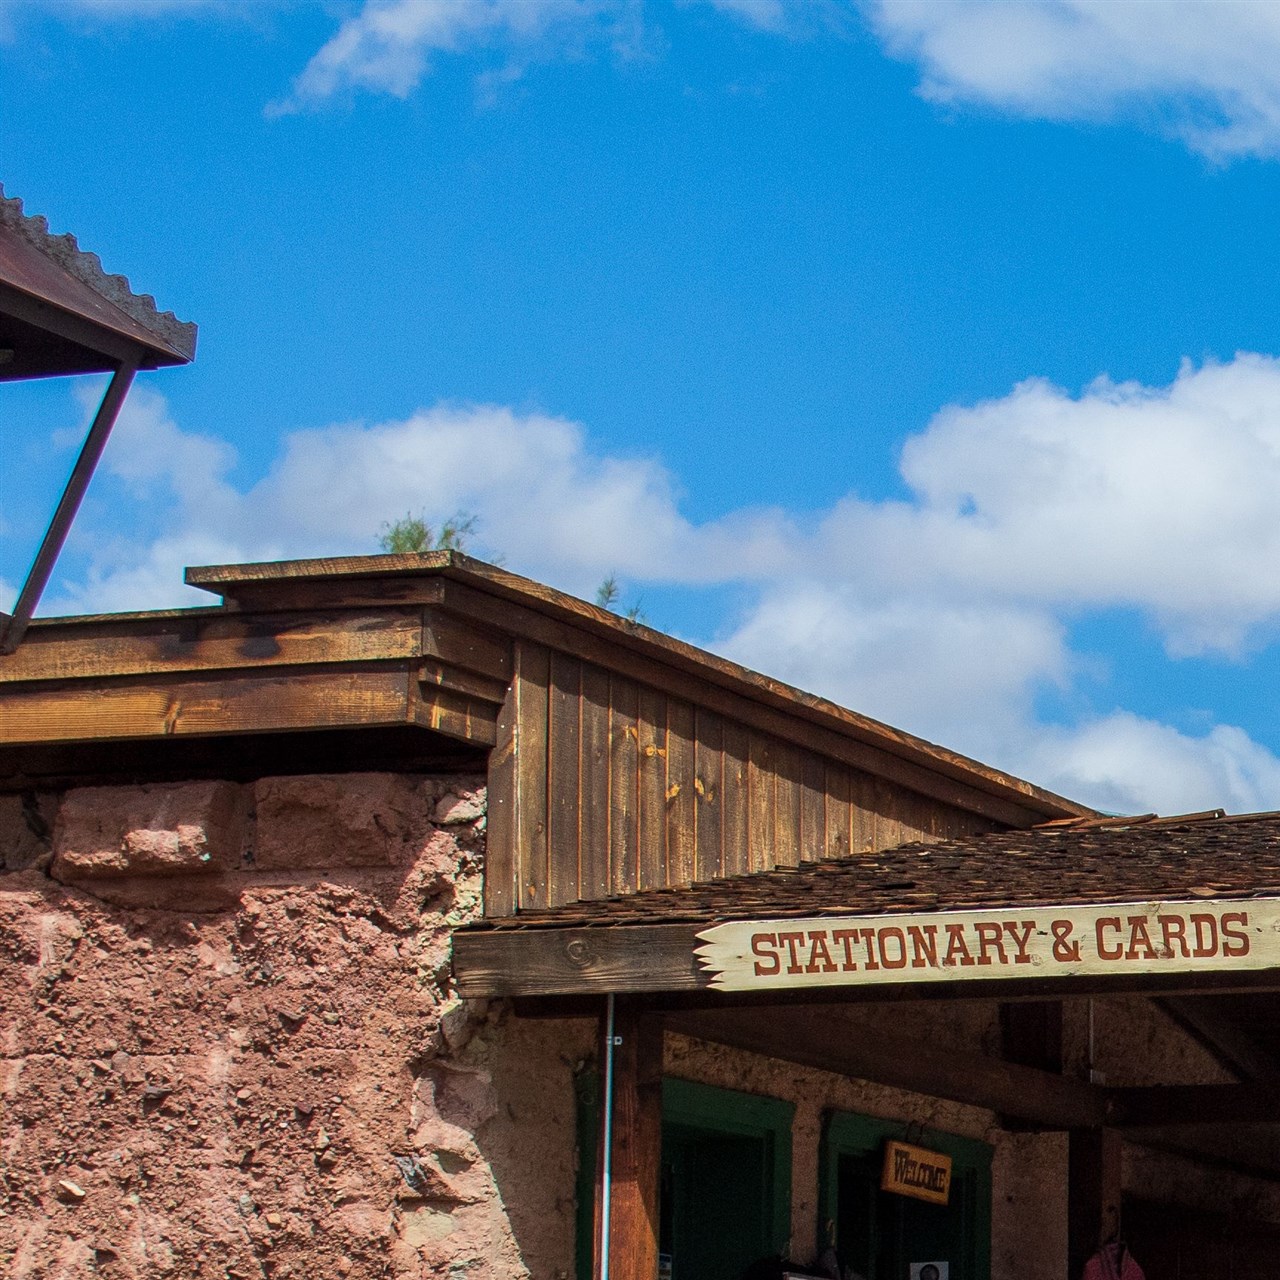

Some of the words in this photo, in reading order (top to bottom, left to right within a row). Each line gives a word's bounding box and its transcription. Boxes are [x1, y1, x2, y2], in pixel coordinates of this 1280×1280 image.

[751, 920, 1037, 977] STATIONARY
[1051, 918, 1082, 962] &
[1096, 911, 1250, 960] CARDS
[894, 1149, 947, 1193] WELCOME
